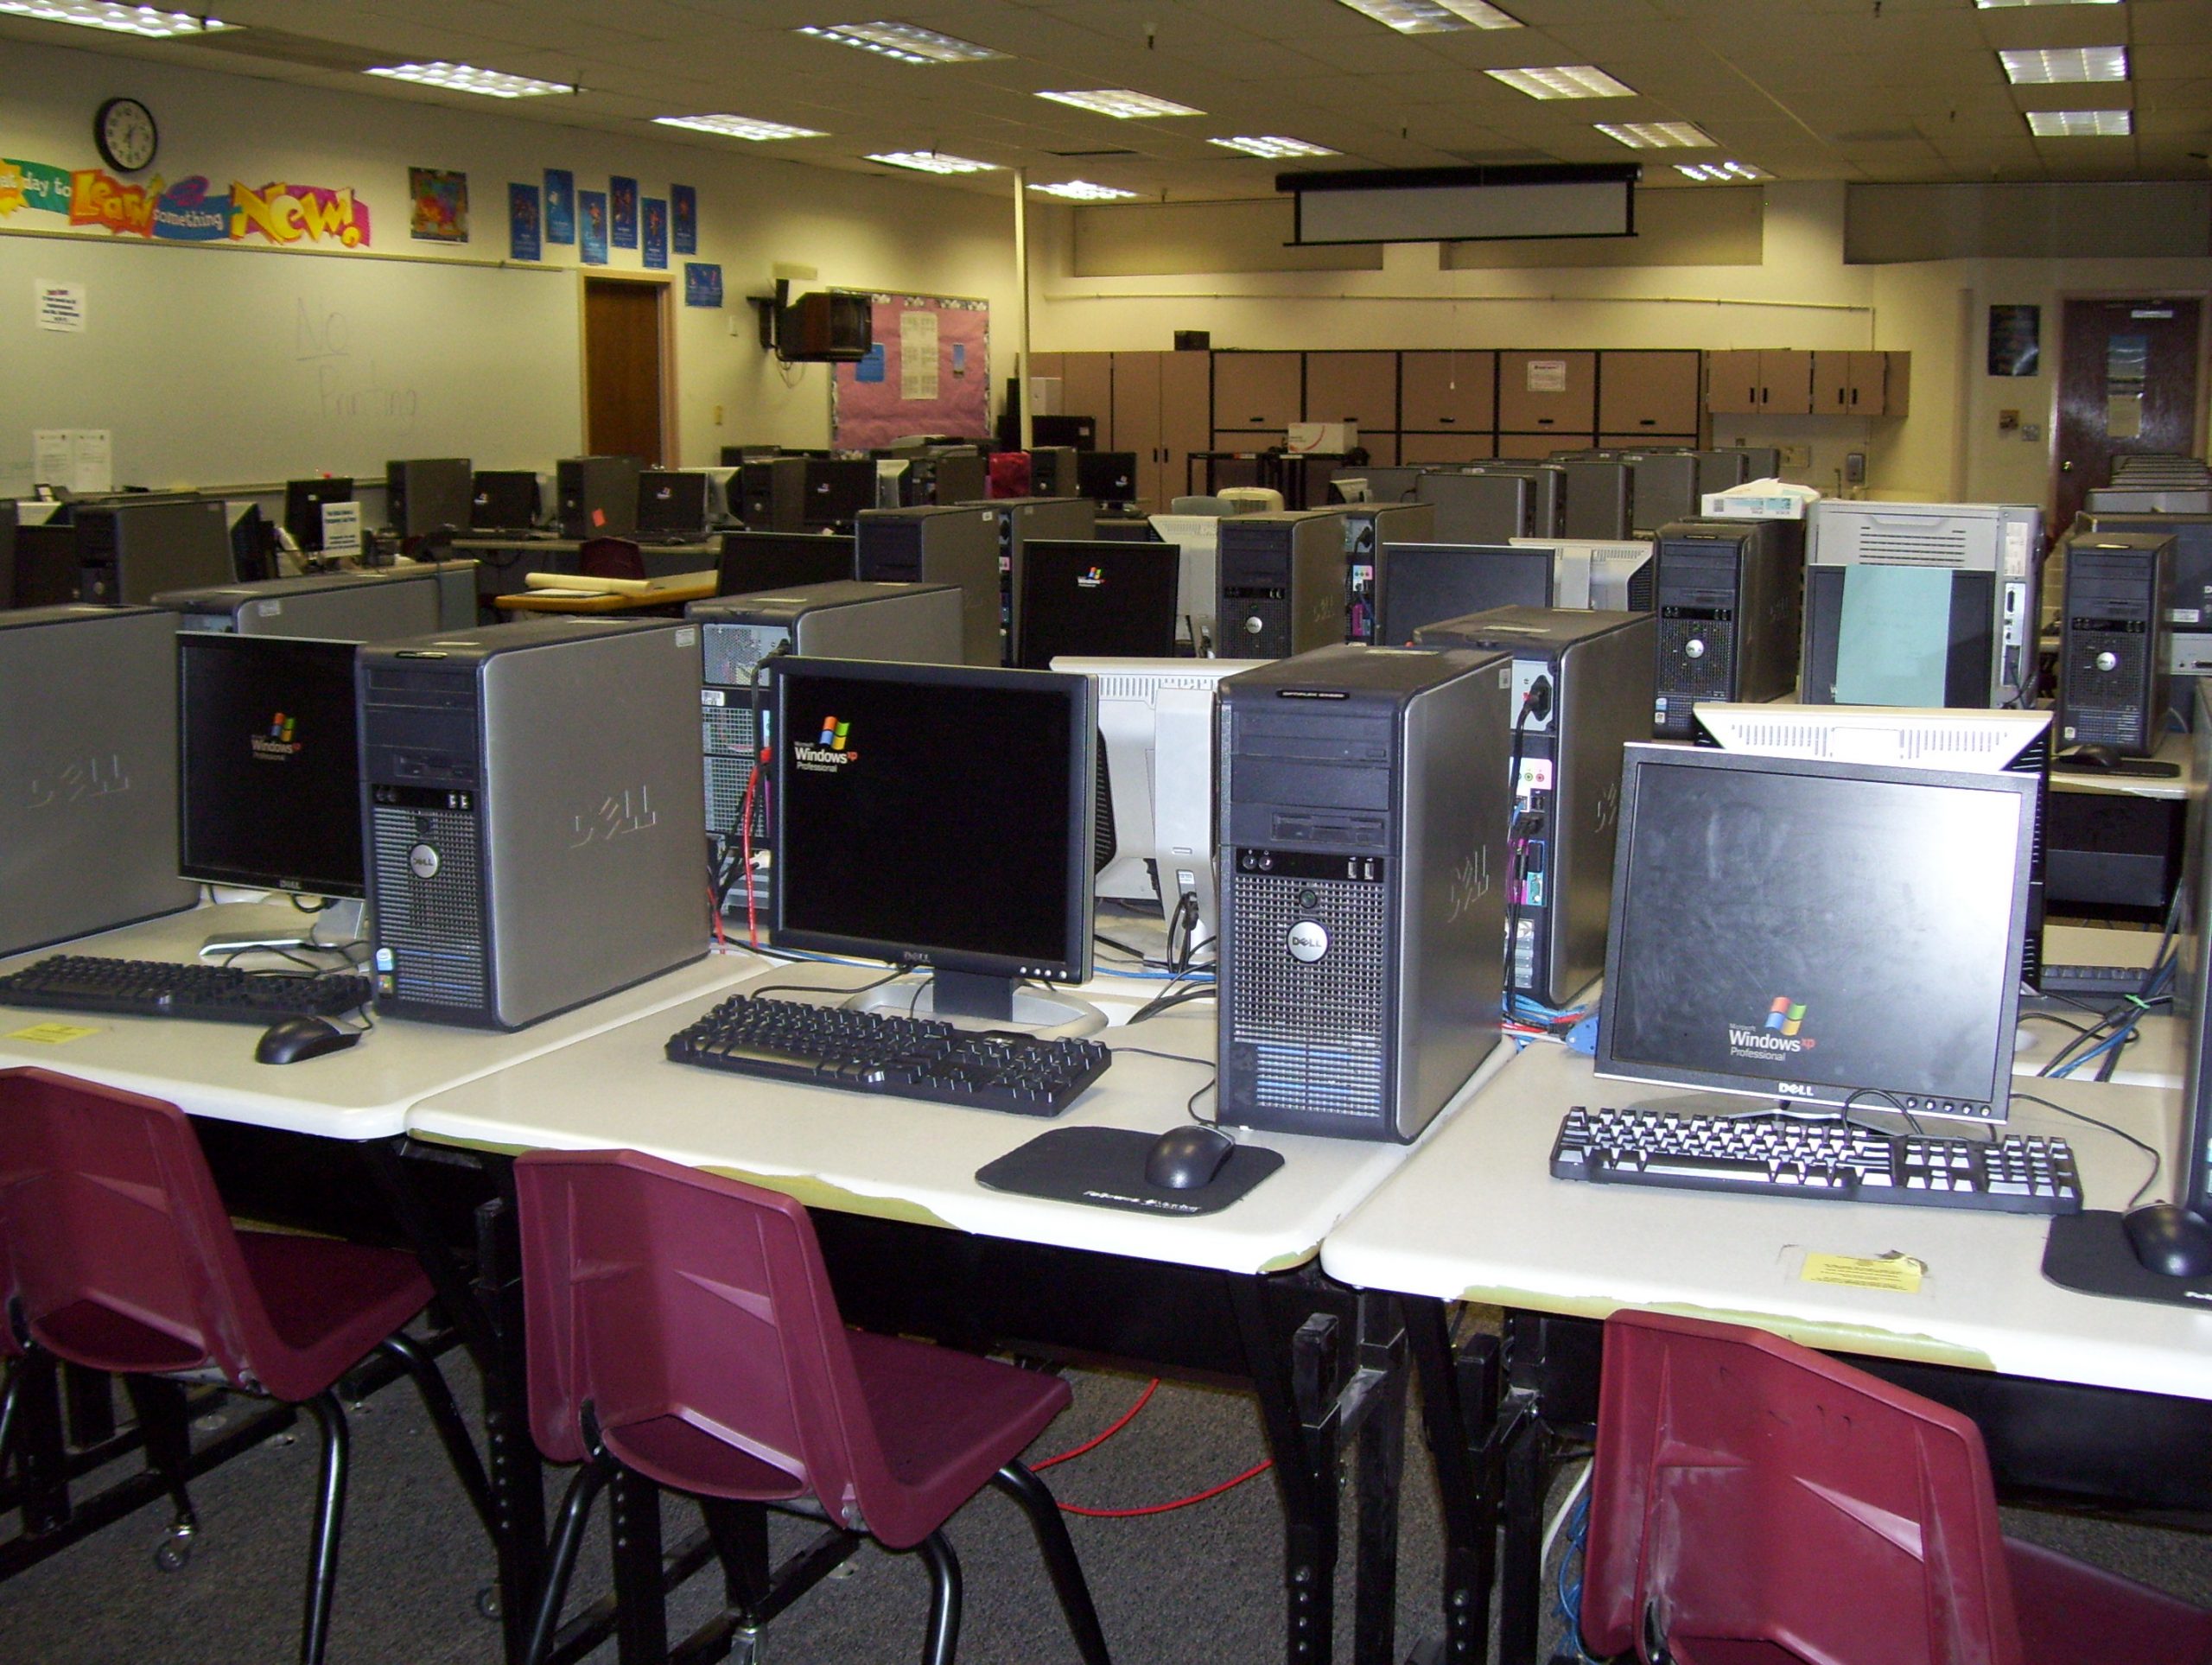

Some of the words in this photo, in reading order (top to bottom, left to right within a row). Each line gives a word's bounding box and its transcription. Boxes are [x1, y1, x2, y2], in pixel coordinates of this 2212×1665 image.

[23, 171, 48, 197] day
[55, 176, 72, 197] to
[153, 208, 225, 232] something
[794, 747, 848, 764] Windows
[1292, 936, 1323, 948] DELL
[1729, 1029, 1802, 1052] Windows
[1730, 1046, 1786, 1062] Professional
[1778, 1083, 1815, 1096] DELL
